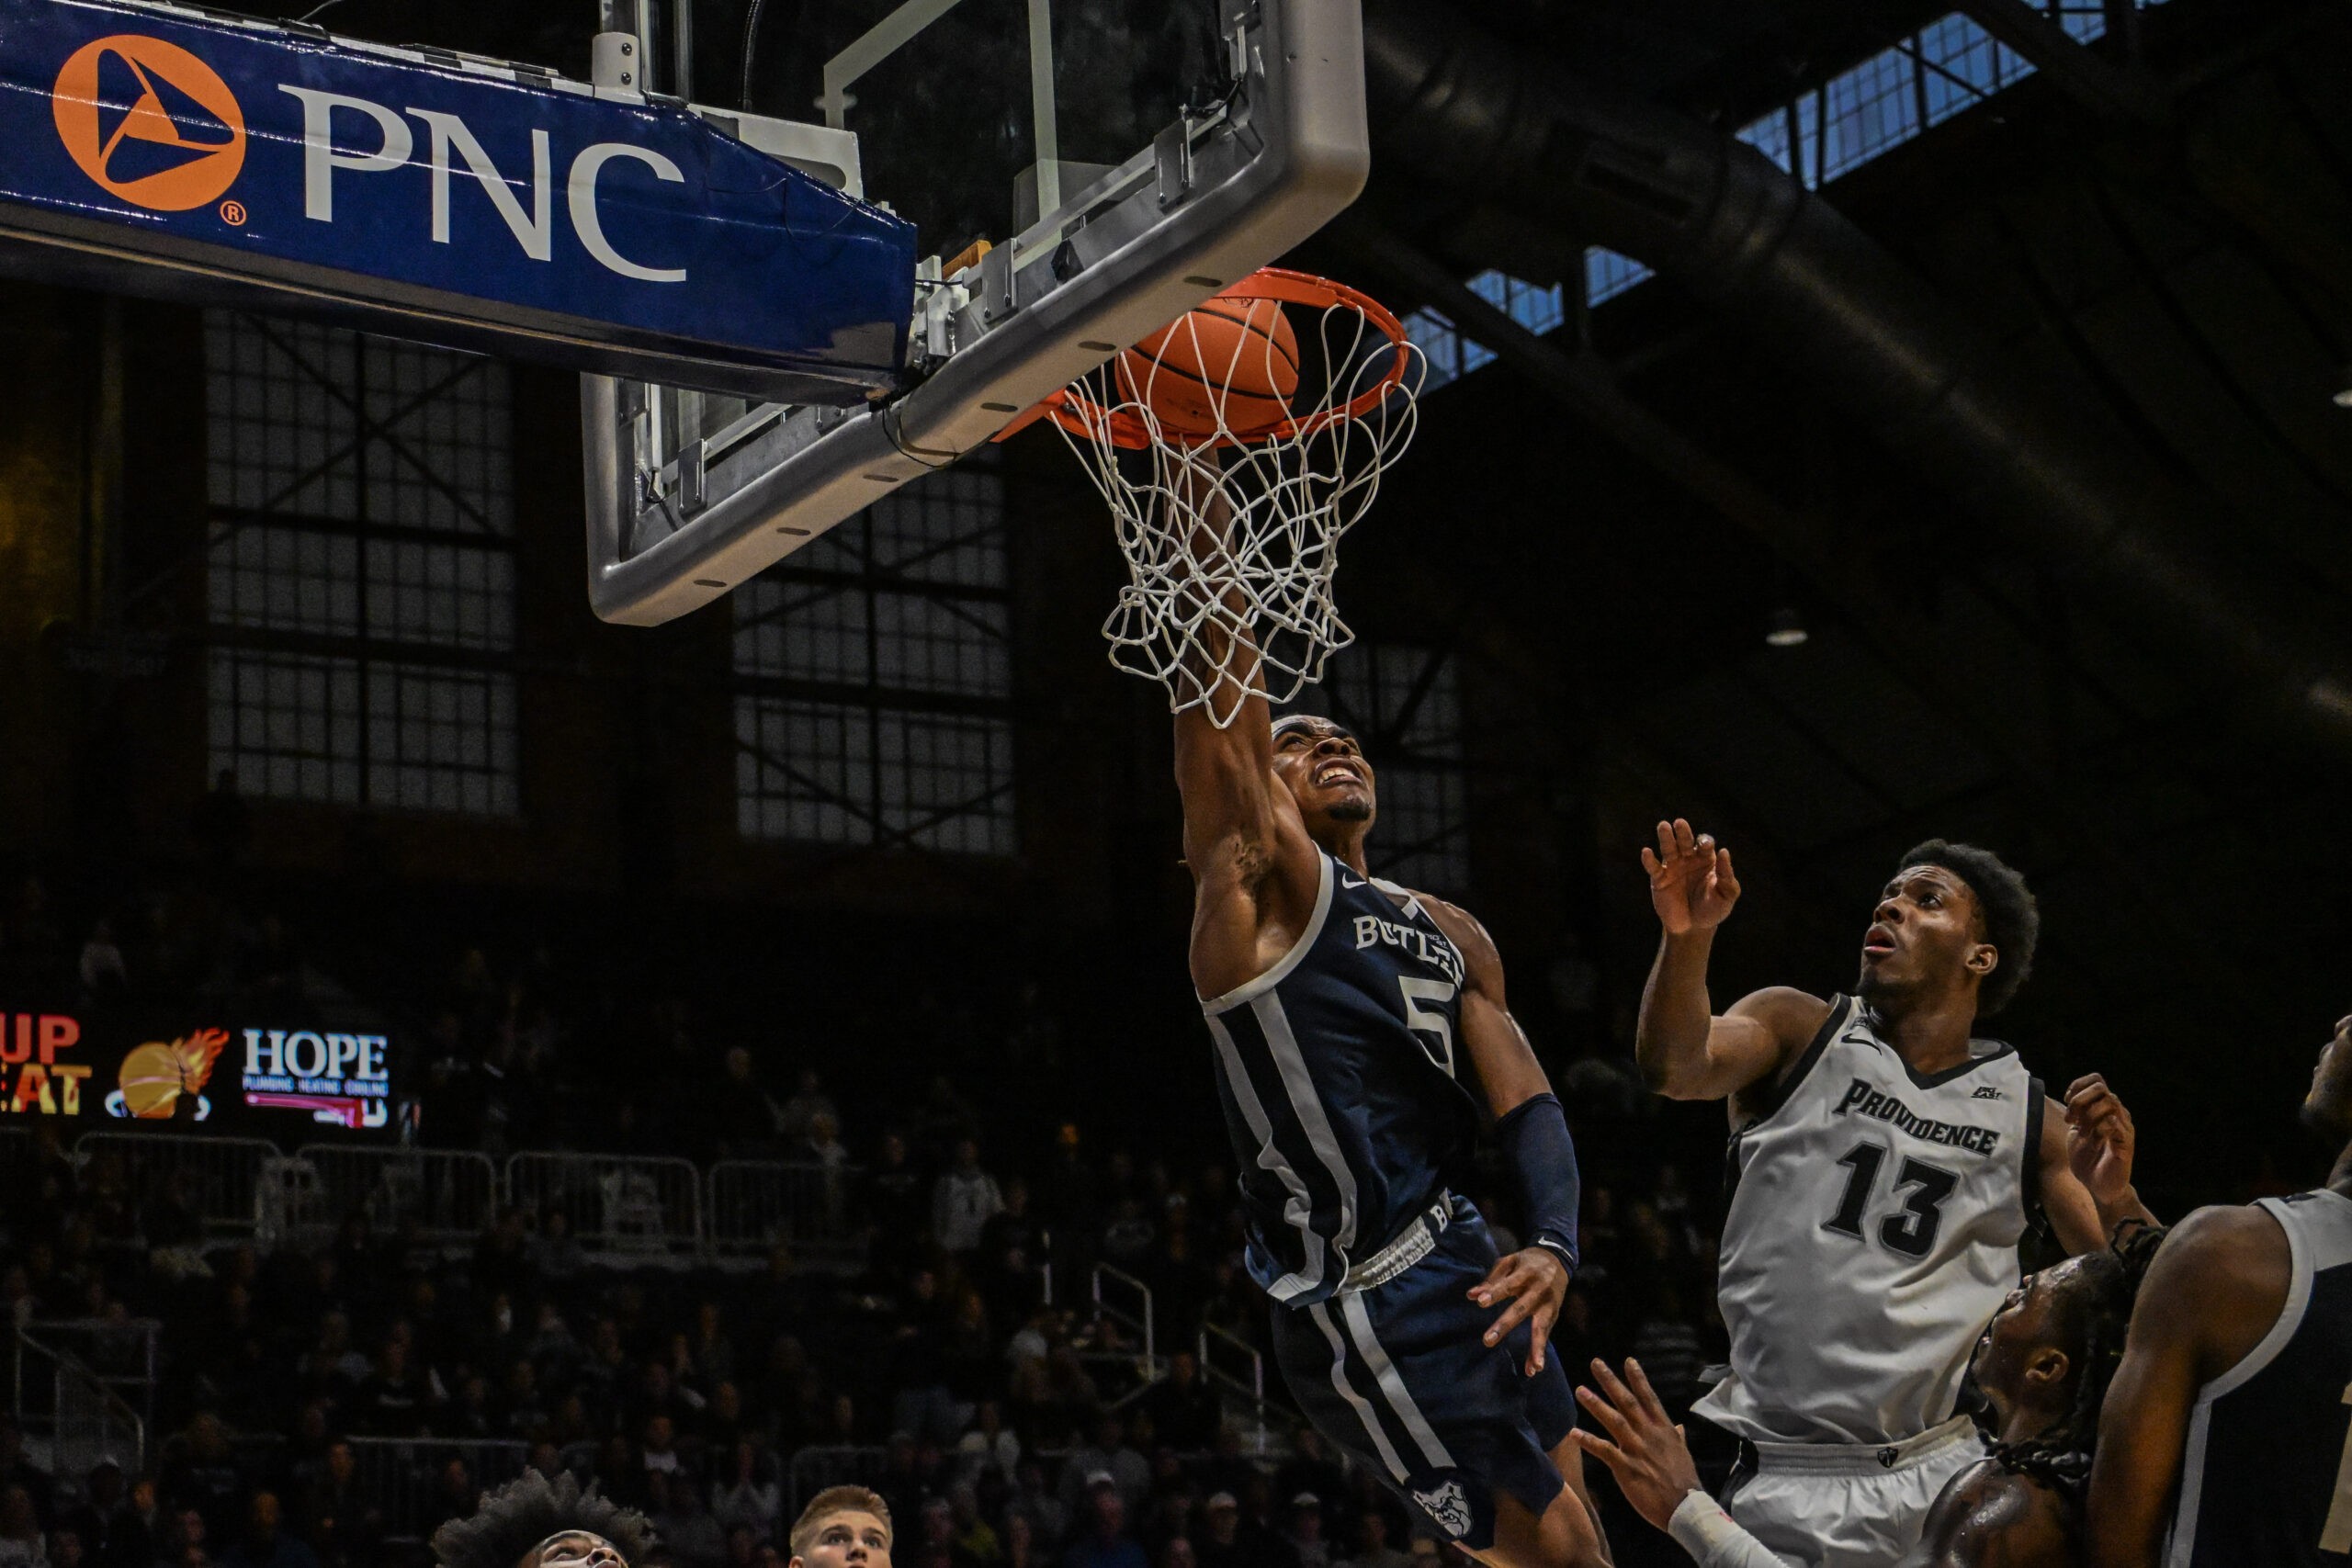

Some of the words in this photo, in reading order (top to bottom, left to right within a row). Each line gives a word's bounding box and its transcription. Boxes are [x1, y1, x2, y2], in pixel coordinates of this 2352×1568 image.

[277, 85, 687, 283] PNC
[0, 1011, 82, 1065] UP
[242, 1028, 390, 1081] HOPE
[1398, 975, 1455, 1080] 5
[1832, 1077, 2001, 1158] PROVIDENCE
[1820, 1140, 1961, 1260] 13
